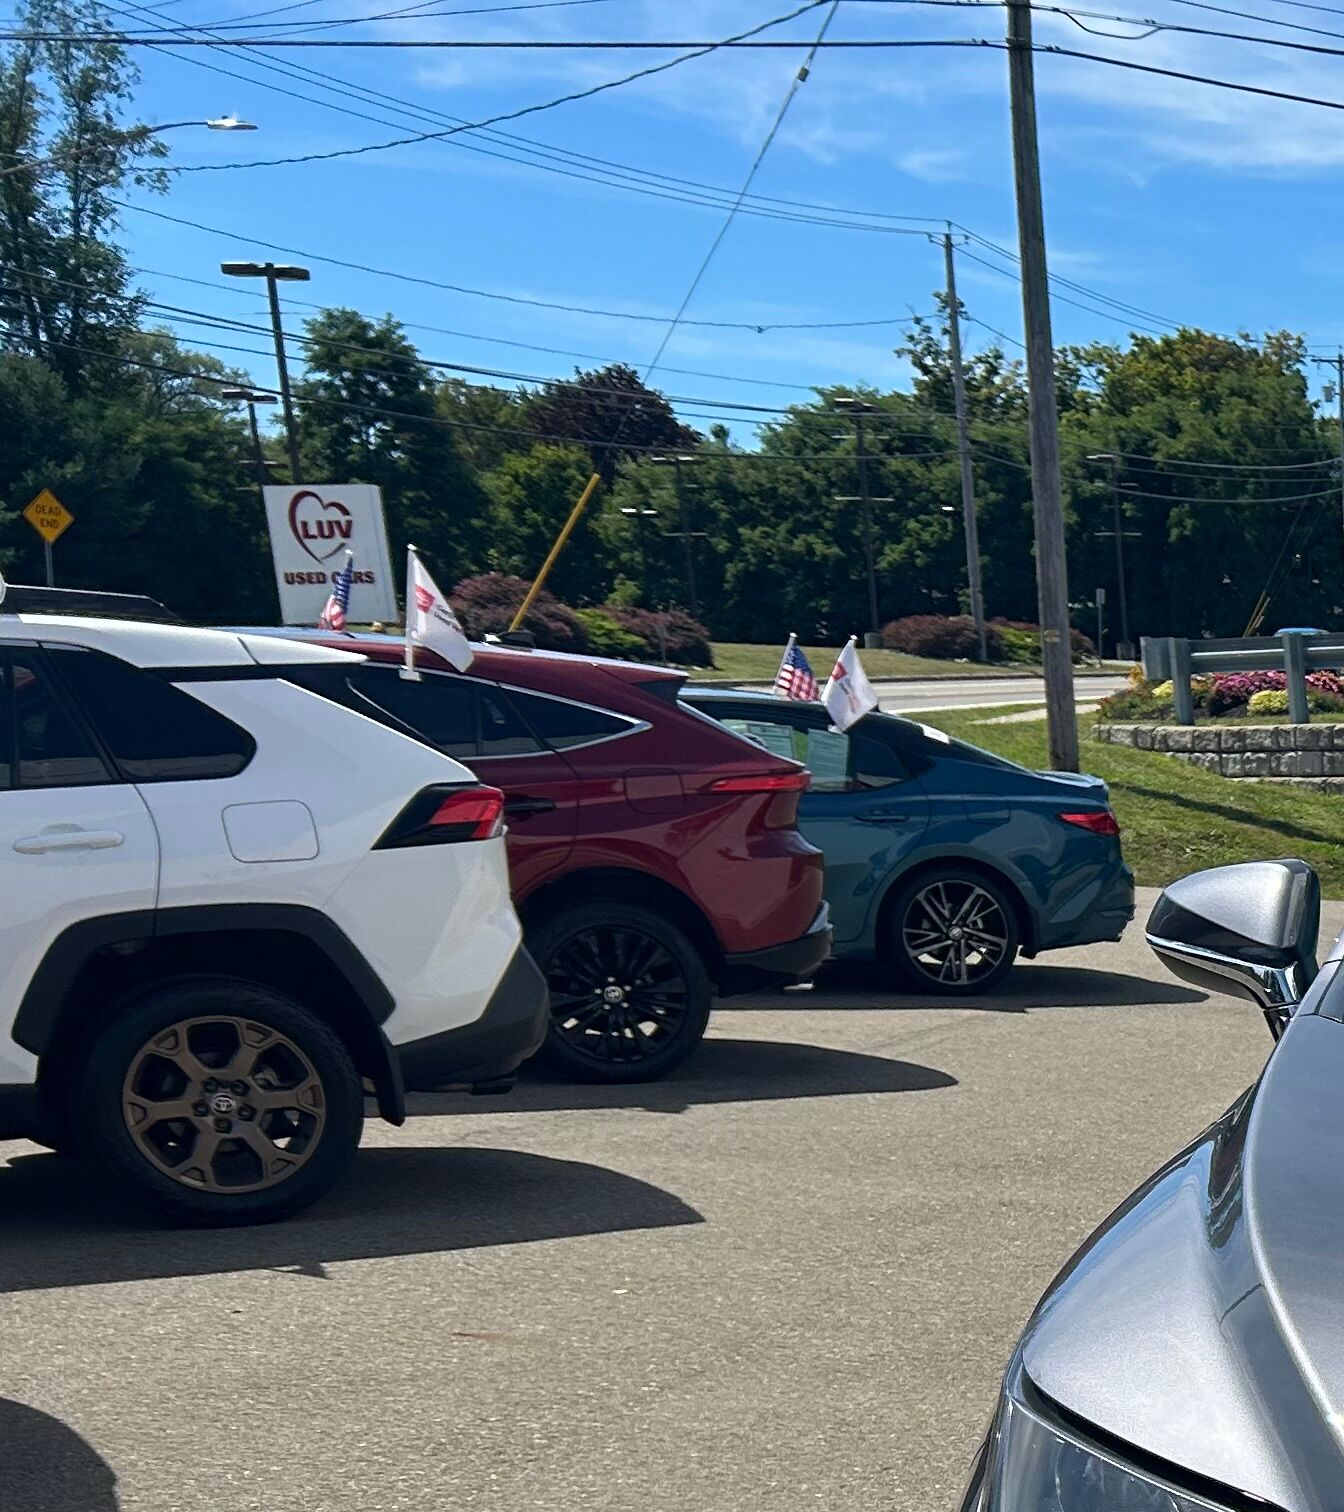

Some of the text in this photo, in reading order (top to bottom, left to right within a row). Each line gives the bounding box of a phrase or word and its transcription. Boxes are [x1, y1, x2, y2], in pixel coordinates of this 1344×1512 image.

[35, 503, 61, 516] DEAD
[40, 518, 59, 529] END
[300, 519, 353, 540] LUV
[284, 570, 376, 585] USED CRS
